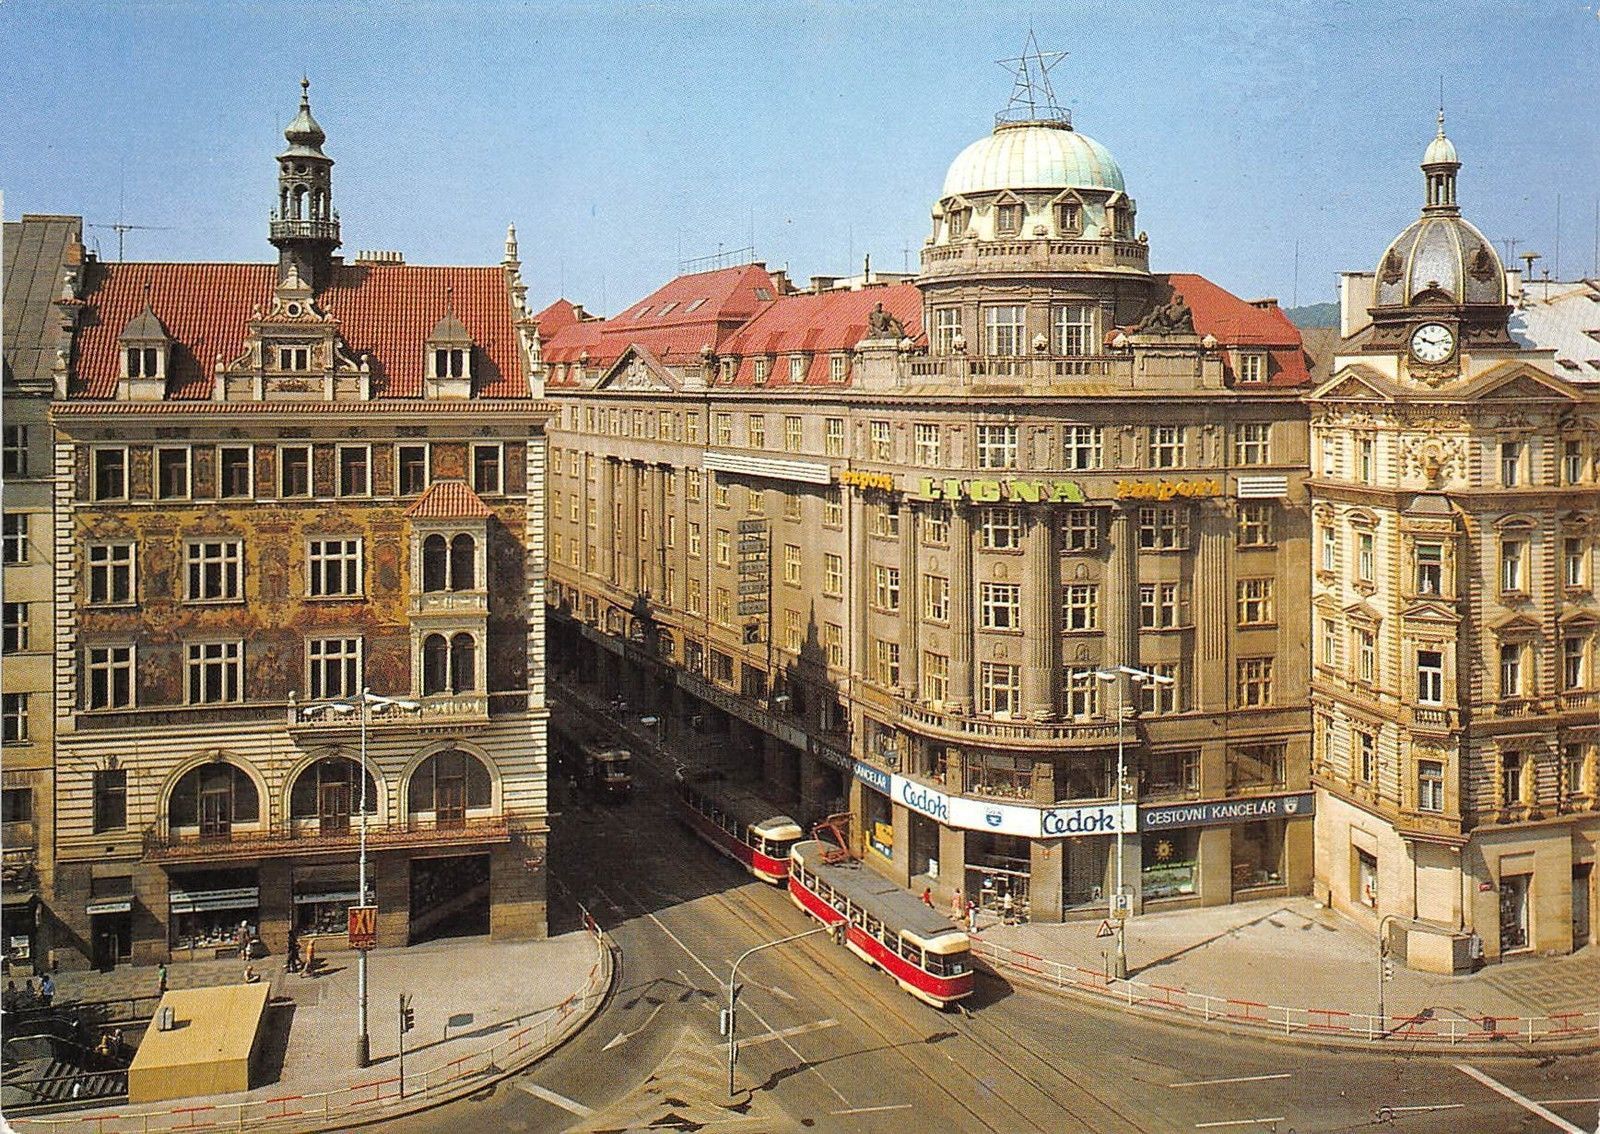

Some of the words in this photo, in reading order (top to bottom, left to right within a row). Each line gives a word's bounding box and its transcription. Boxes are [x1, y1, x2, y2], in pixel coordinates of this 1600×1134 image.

[919, 477, 1086, 504] LIGNA
[902, 781, 948, 820] Čedok
[1043, 807, 1116, 836] Čedok
[1146, 808, 1207, 825] CESTOVNÍ
